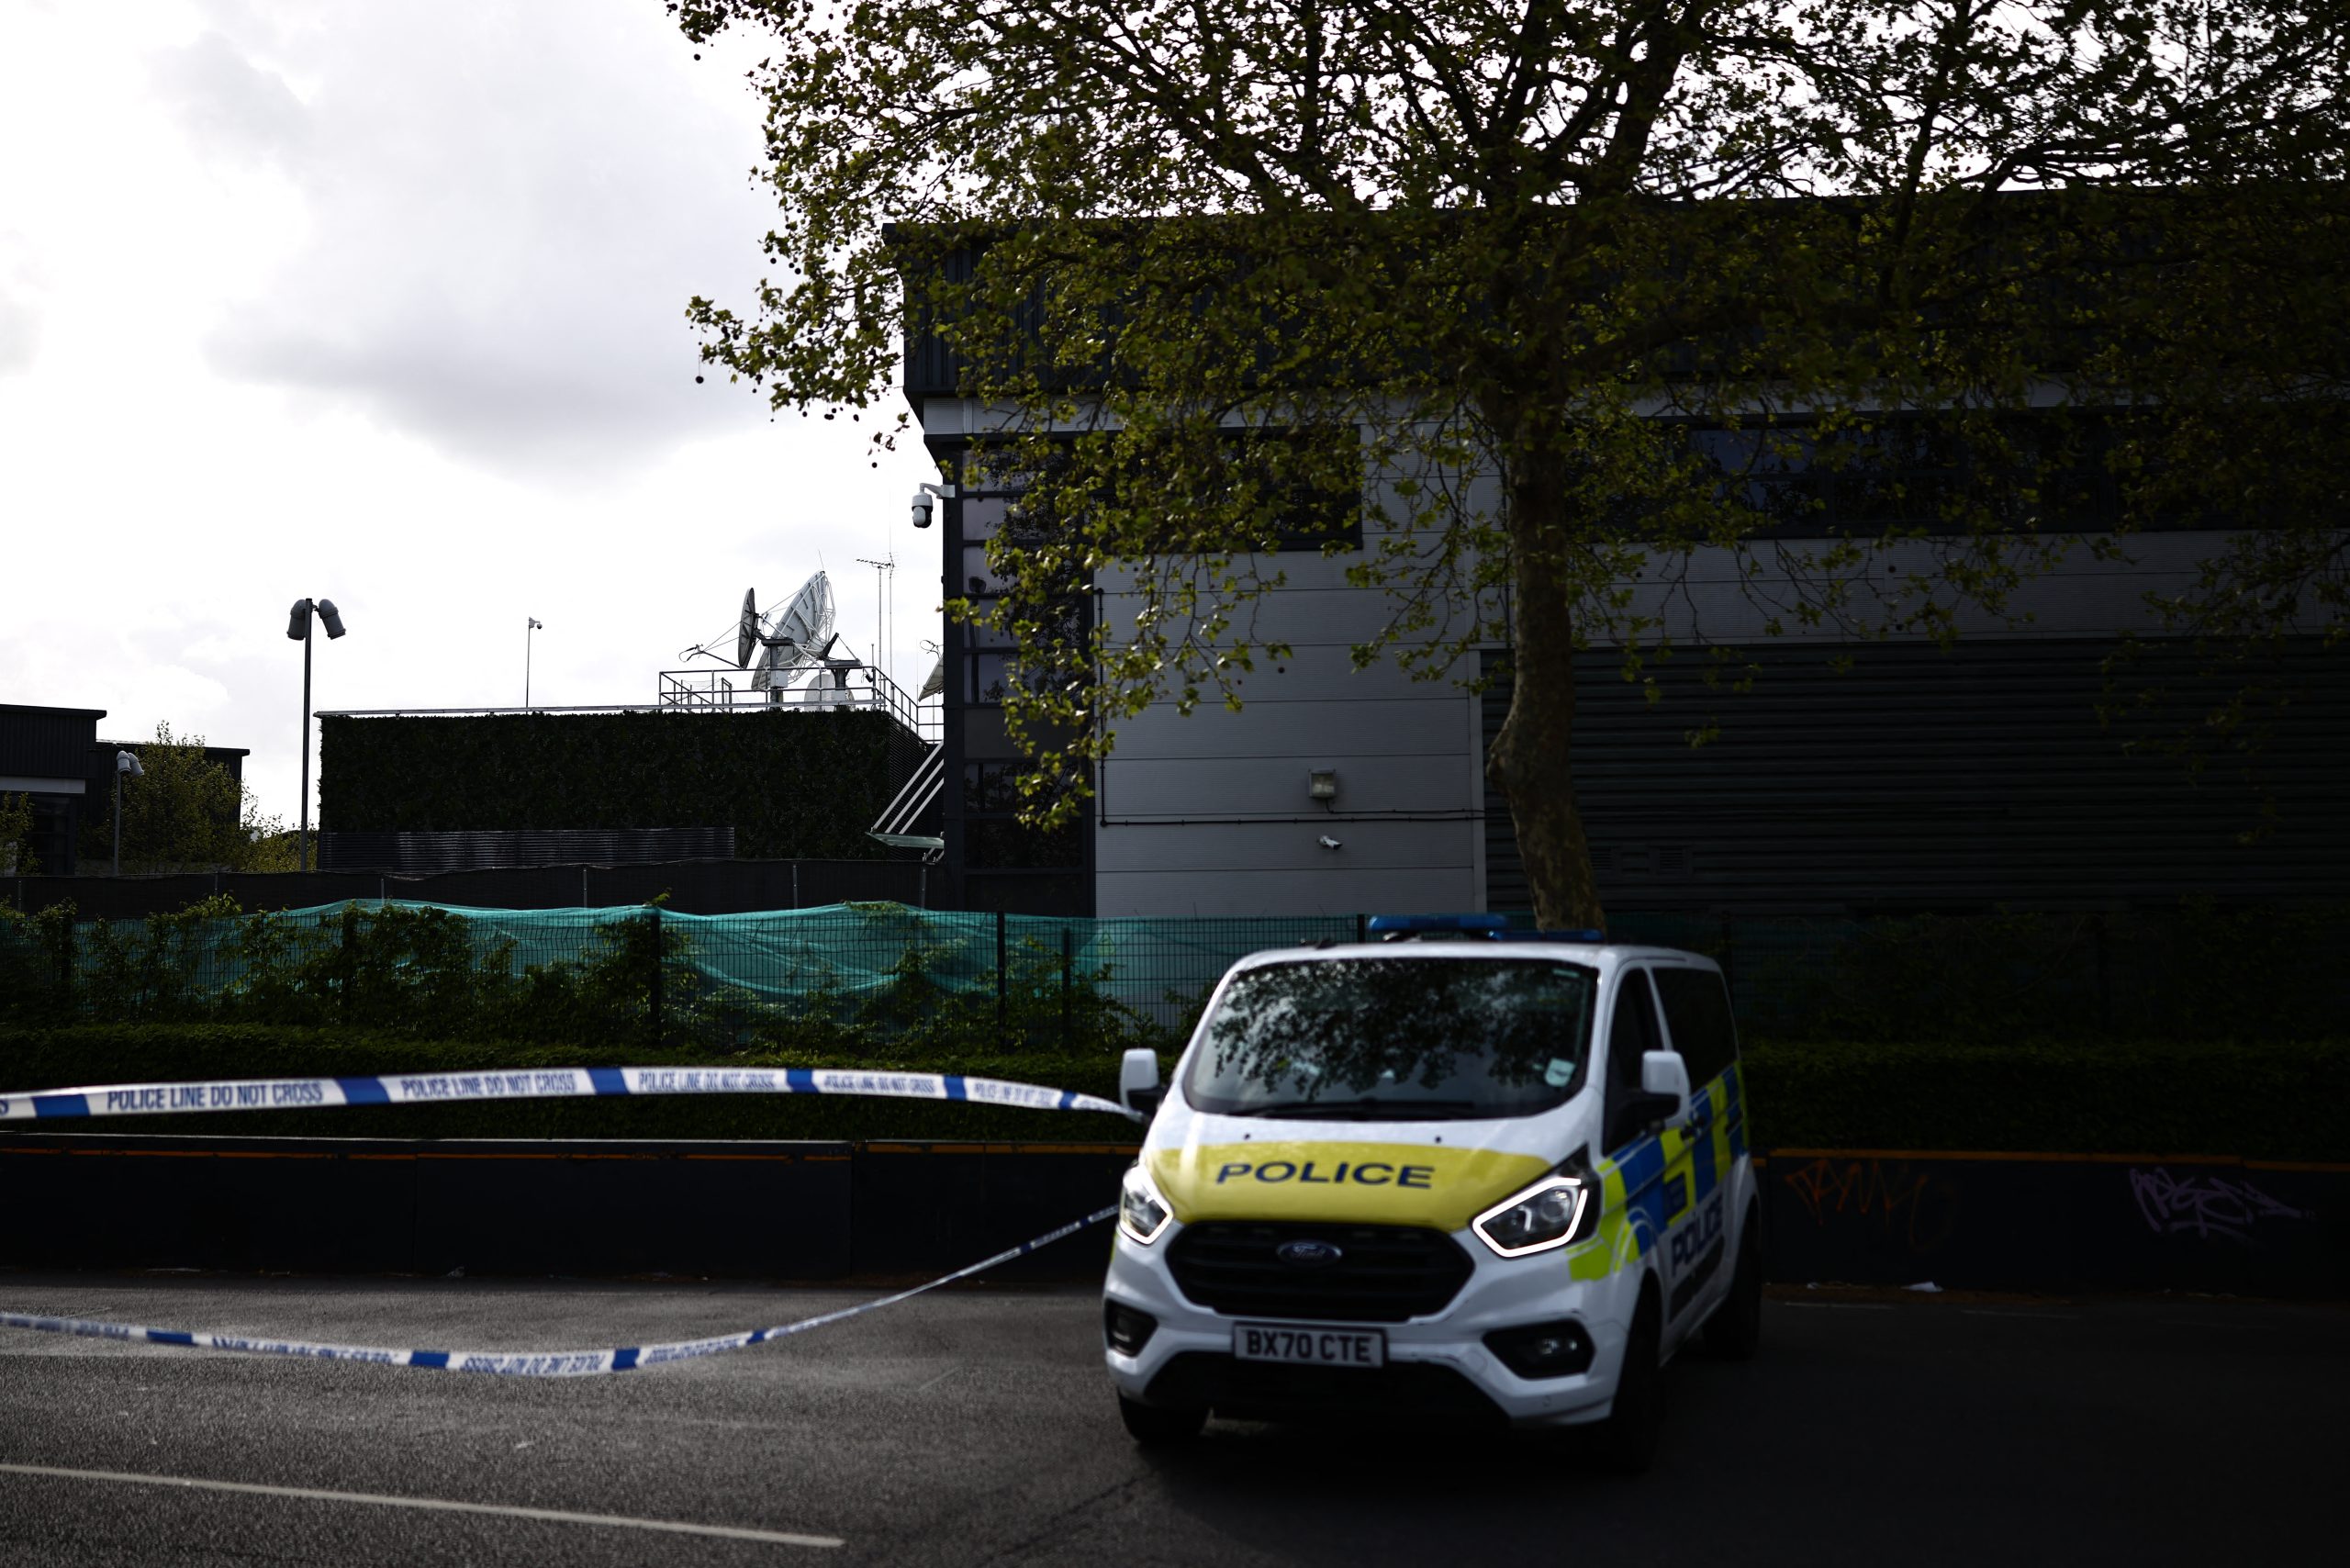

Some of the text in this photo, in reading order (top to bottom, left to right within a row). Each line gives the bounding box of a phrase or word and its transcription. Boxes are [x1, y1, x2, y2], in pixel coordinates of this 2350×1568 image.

[401, 1072, 577, 1099] POLICE LINE DO NOT CROSS
[639, 1071, 675, 1092] POLICE
[678, 1071, 699, 1091] LINE
[107, 1082, 322, 1111] POLICE LINE DO NOT CROSS
[1216, 1161, 1435, 1189] POLICE
[1671, 1192, 1723, 1278] POLICE
[1247, 1330, 1371, 1362] BX70 CTE
